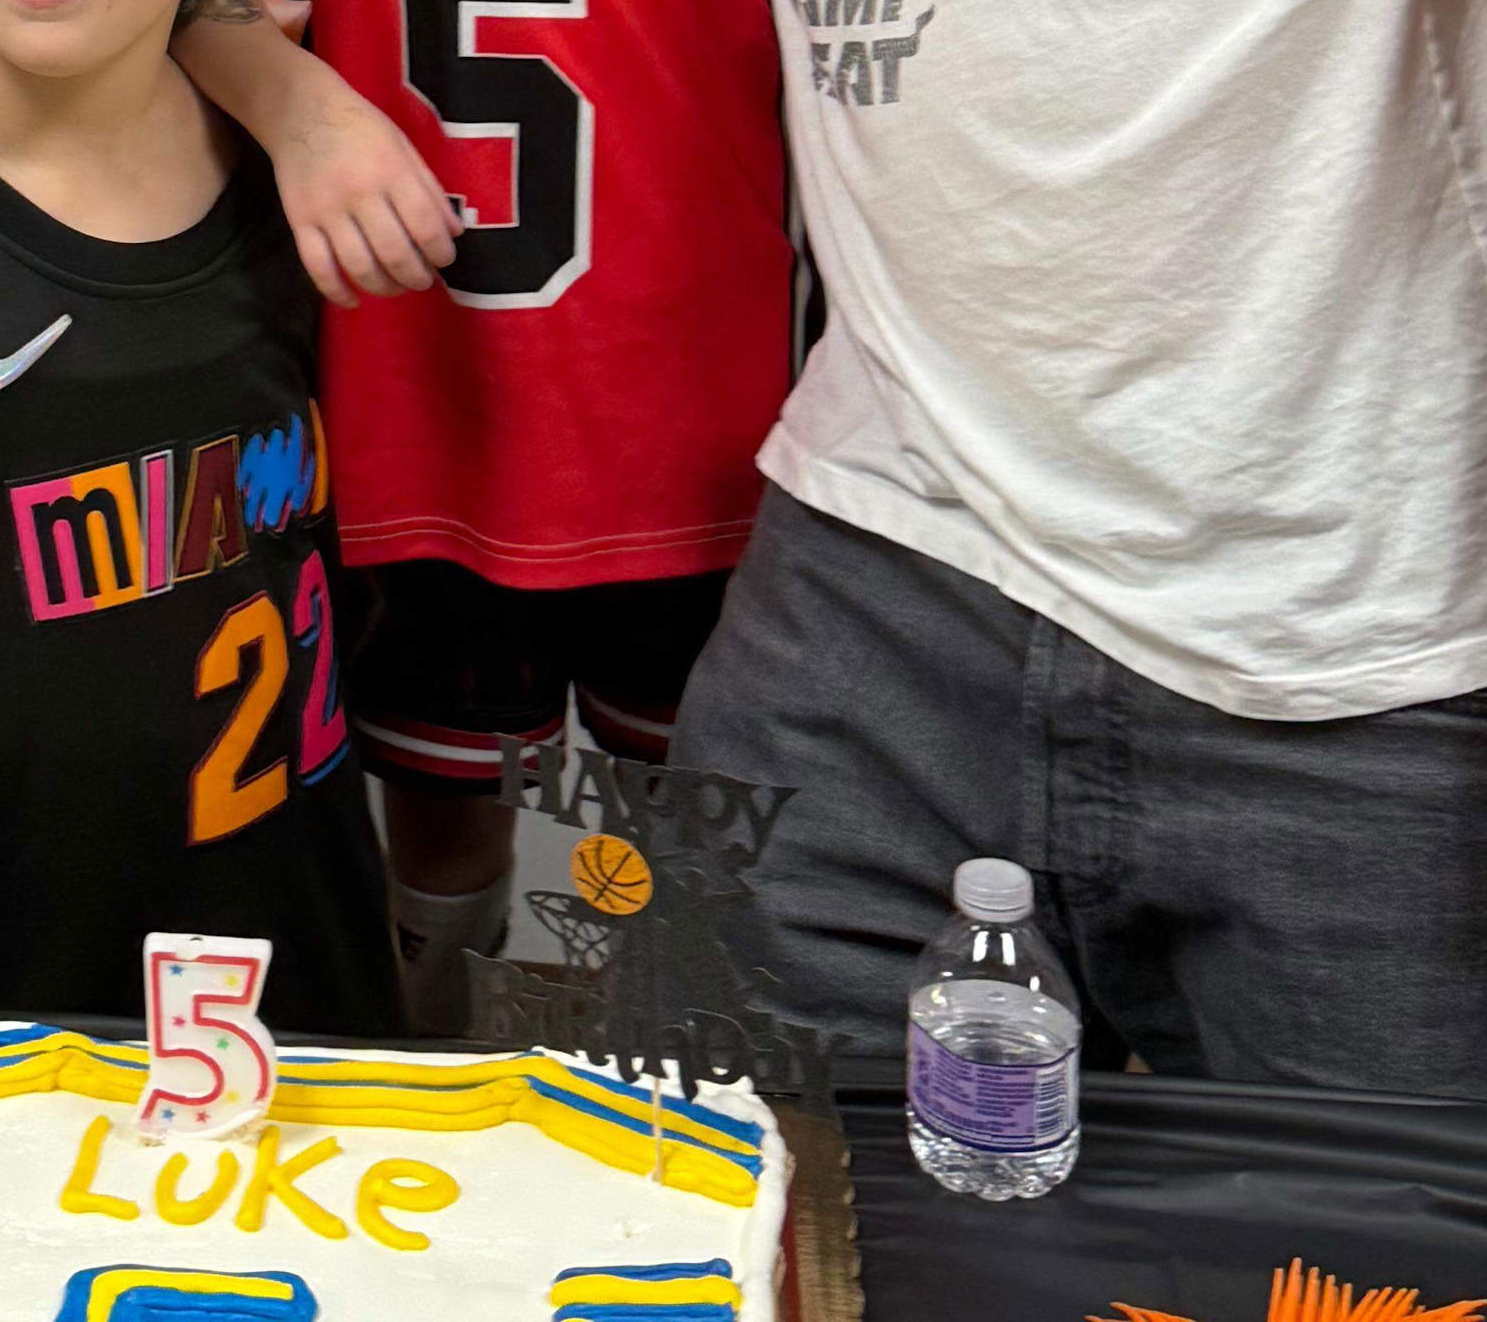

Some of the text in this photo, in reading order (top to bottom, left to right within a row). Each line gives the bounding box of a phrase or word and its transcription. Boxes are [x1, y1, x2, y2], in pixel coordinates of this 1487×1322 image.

[811, 4, 935, 106] EAT
[186, 549, 351, 847] 22
[135, 932, 277, 1137] 5
